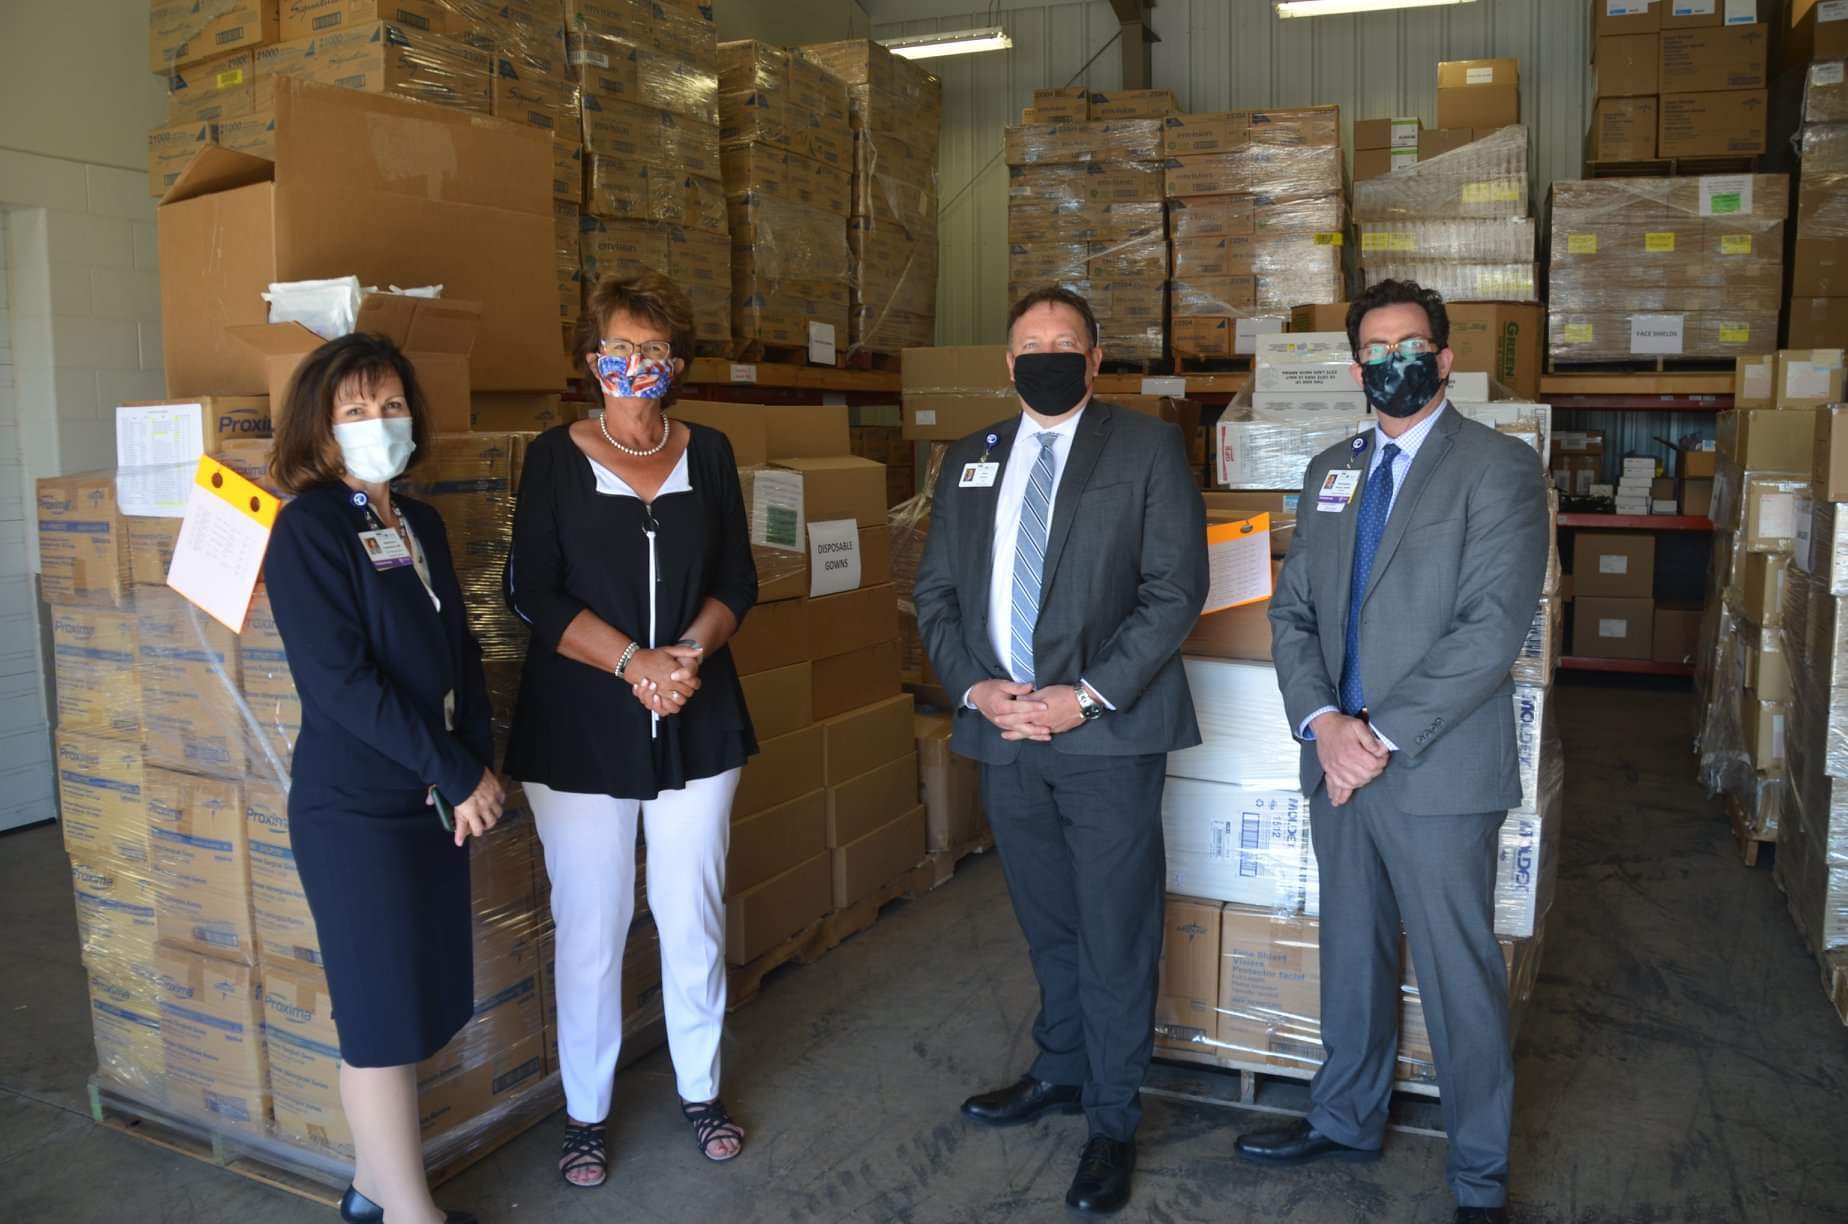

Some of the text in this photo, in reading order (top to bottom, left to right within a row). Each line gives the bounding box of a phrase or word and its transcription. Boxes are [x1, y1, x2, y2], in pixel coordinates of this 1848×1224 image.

[218, 415, 273, 433] Proxi
[817, 541, 853, 554] DISPOSABLE
[824, 558, 849, 571] GOWNS
